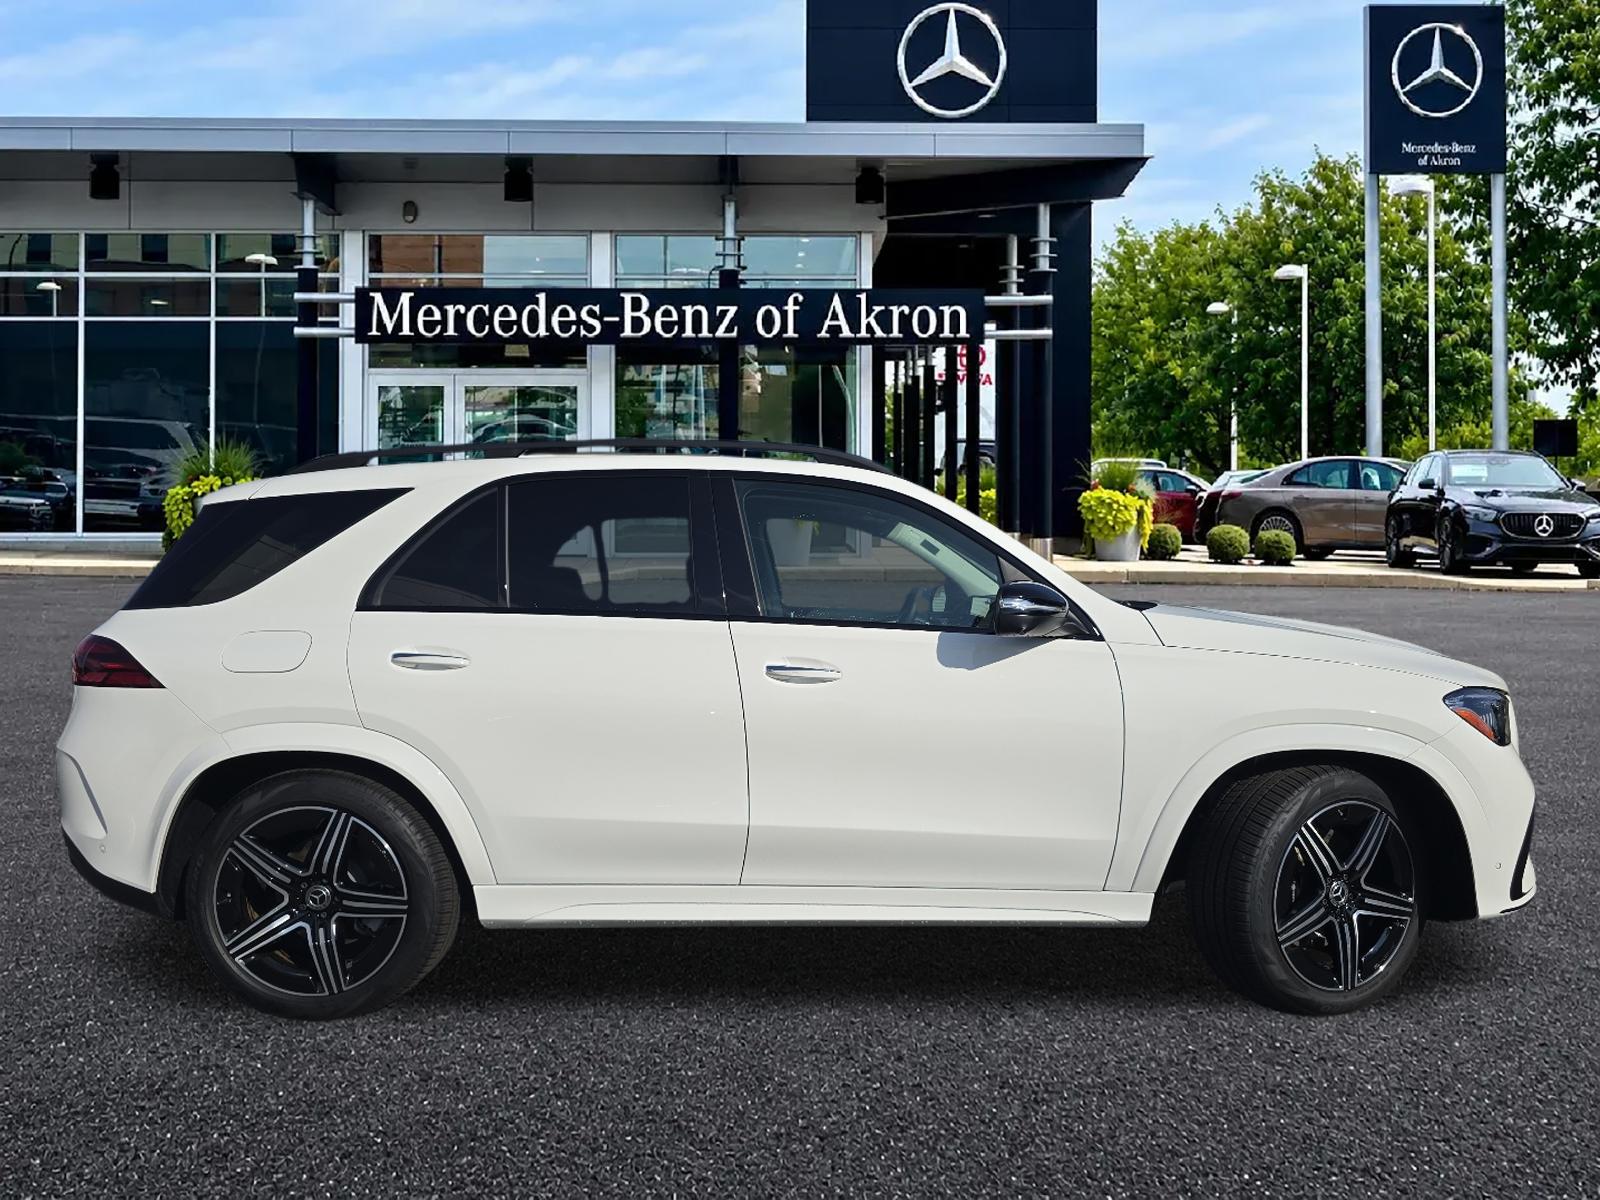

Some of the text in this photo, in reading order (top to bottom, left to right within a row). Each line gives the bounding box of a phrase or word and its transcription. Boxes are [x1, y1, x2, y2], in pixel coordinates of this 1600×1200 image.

[1401, 142, 1476, 153] Mercedes-Benz
[1417, 154, 1461, 166] of Akron
[367, 292, 971, 338] Mercedes-Benz of Akron
